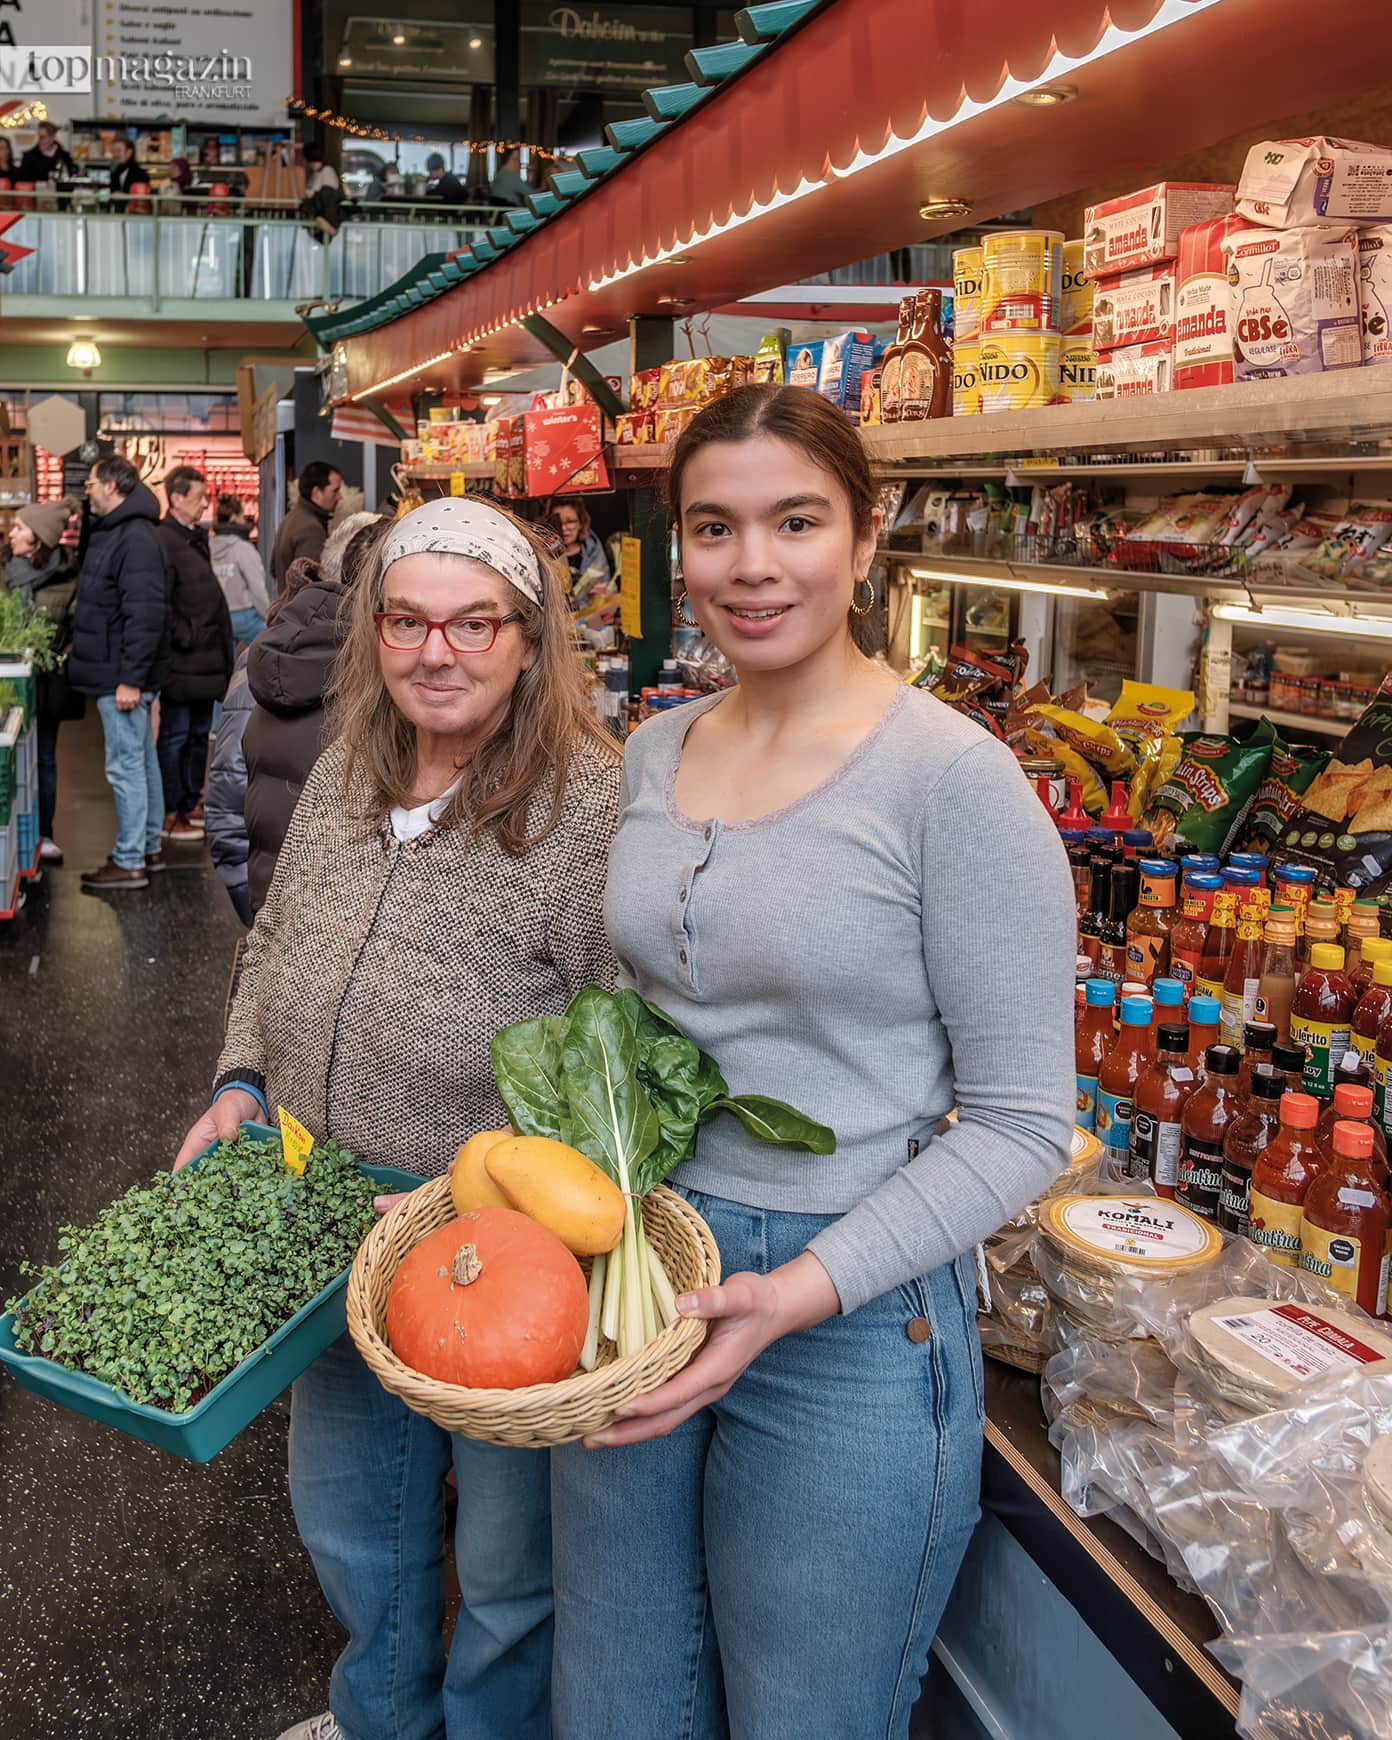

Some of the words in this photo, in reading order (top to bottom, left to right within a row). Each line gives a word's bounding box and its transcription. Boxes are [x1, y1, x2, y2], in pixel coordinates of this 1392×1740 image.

[1109, 224, 1148, 257] amanda
[1061, 272, 1089, 290] DO
[1116, 300, 1156, 330] amanda
[1178, 304, 1227, 342] amanda
[1238, 315, 1288, 343] CBSé
[955, 373, 976, 389] DO
[980, 363, 1029, 381] NIDO
[1191, 768, 1222, 806] Strips
[1098, 1210, 1174, 1230] KOMALI
[1106, 1225, 1160, 1240] TRADICIONAL
